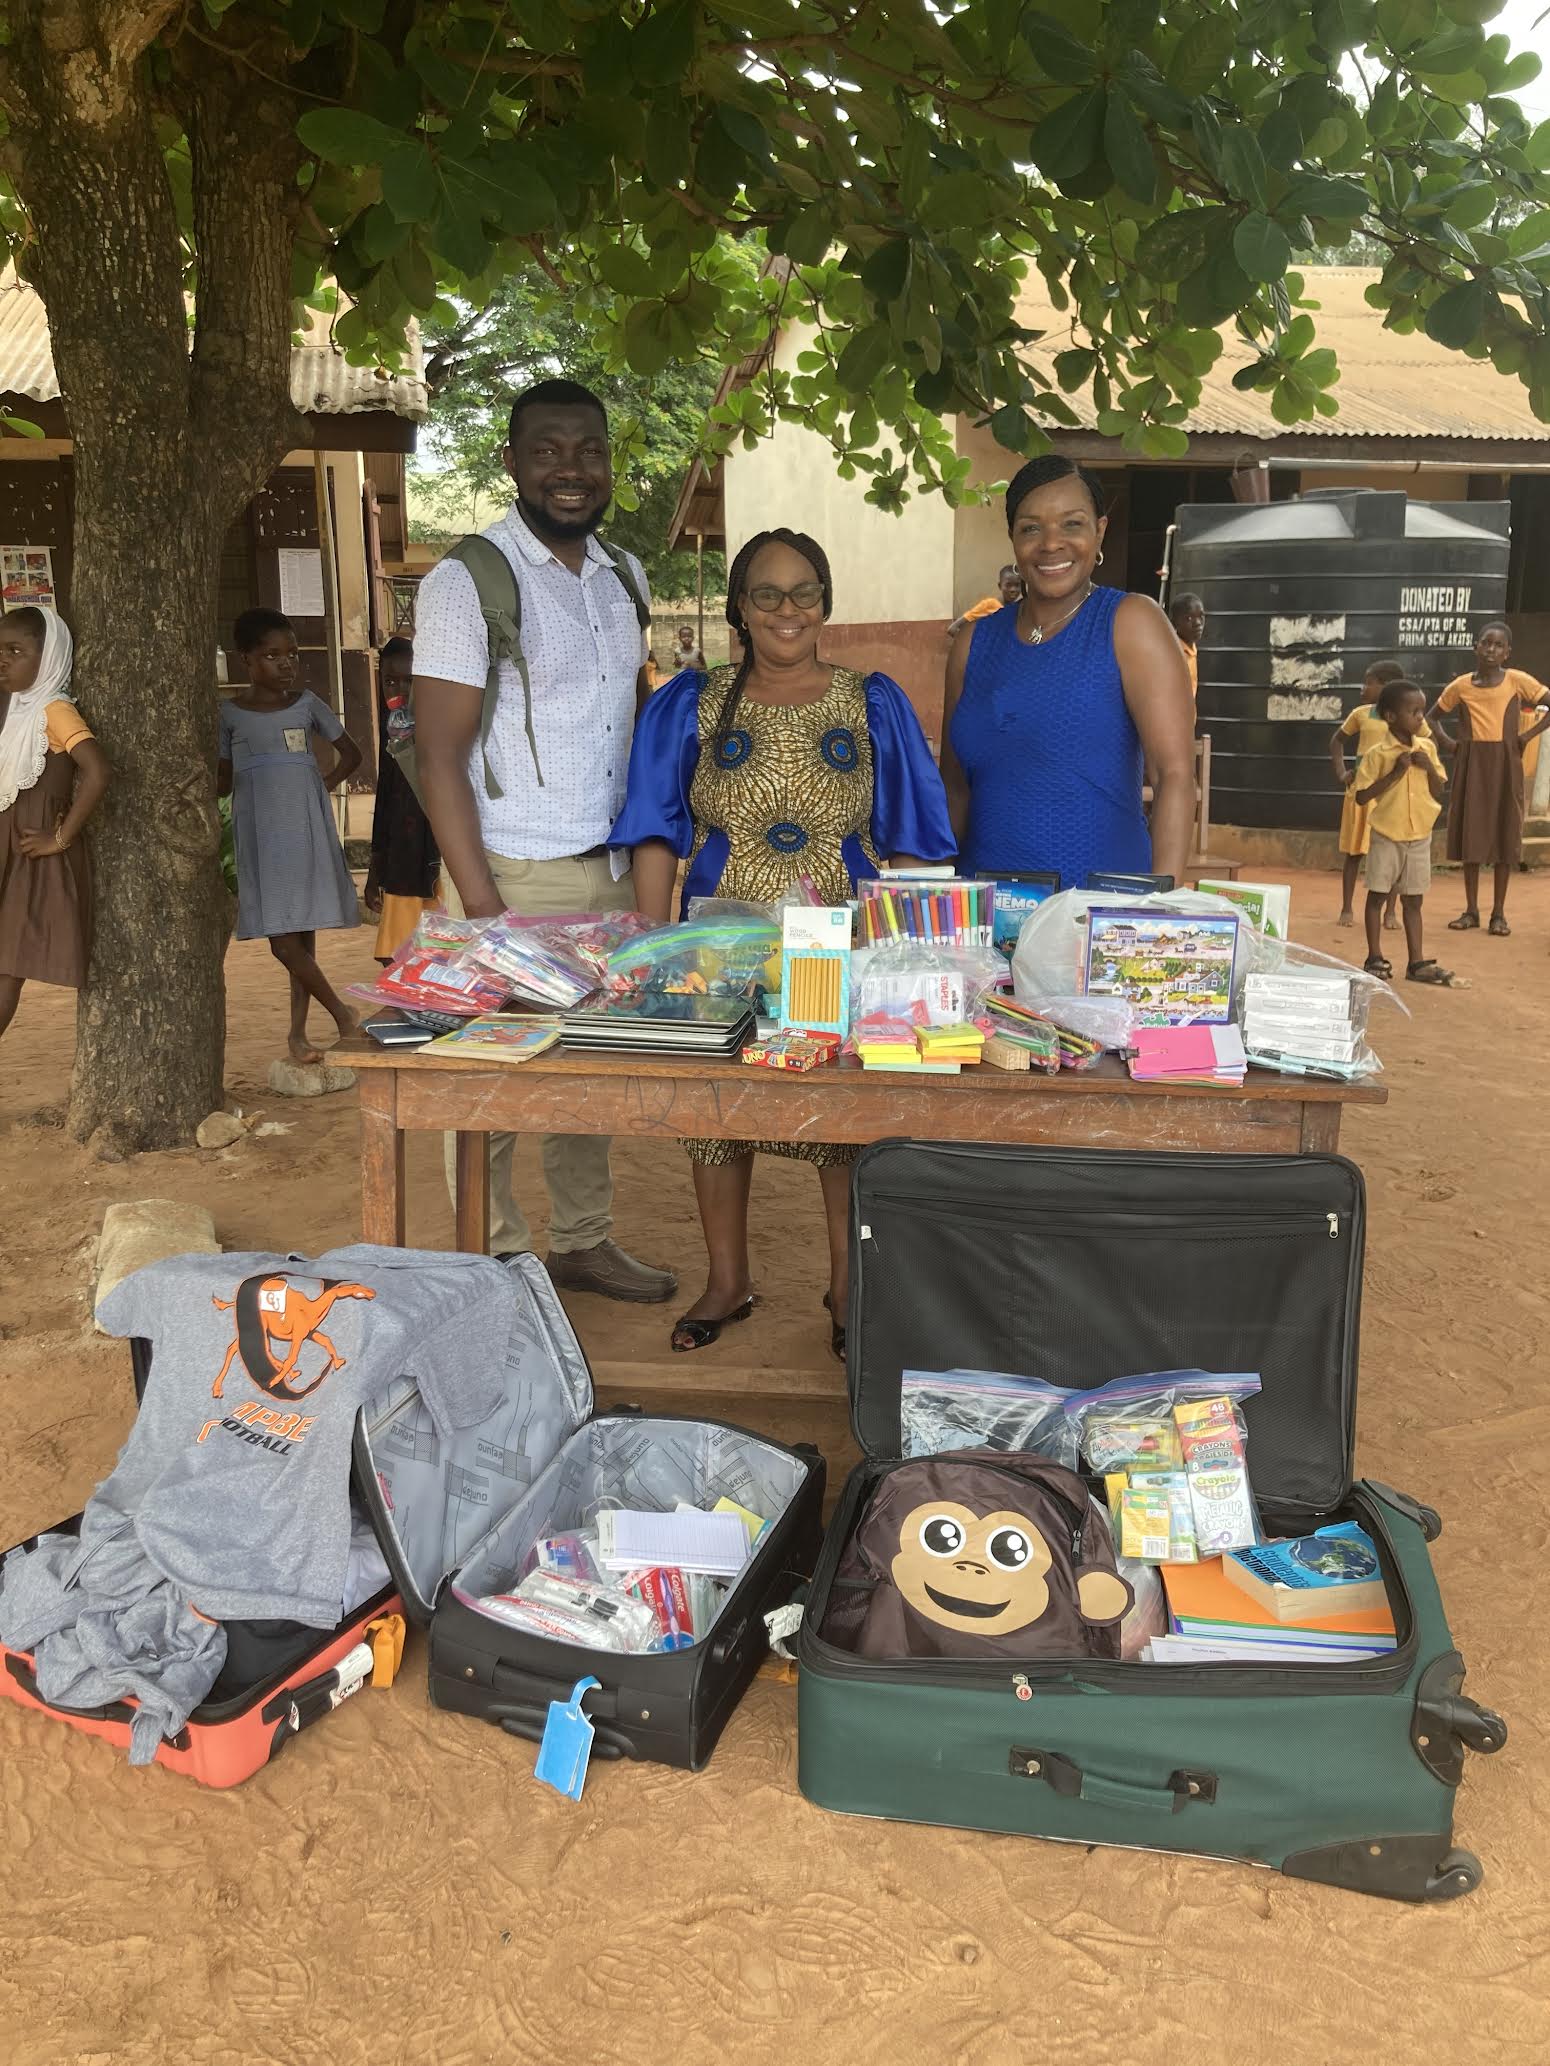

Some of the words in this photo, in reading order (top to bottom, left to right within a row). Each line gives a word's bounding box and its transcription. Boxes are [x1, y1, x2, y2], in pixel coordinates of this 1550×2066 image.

[1400, 587, 1454, 612] DONATED
[1456, 587, 1471, 612] BY
[1443, 618, 1455, 631] OF
[1456, 618, 1467, 631] RC
[1398, 632, 1425, 647] PRIM
[1427, 632, 1445, 647] SCH
[995, 896, 1039, 909] NEMO
[940, 975, 950, 1012] STAPLES
[742, 1050, 765, 1064] UNO
[1211, 1402, 1225, 1413] 48
[1193, 1441, 1232, 1453] CRAYONS
[1193, 1461, 1199, 1472] 8
[1196, 1476, 1237, 1487] Crayola
[1200, 1501, 1244, 1520] METALLIC
[1202, 1519, 1246, 1532] CRAYONS
[644, 1576, 656, 1609] Colga
[671, 1574, 686, 1612] Colgate
